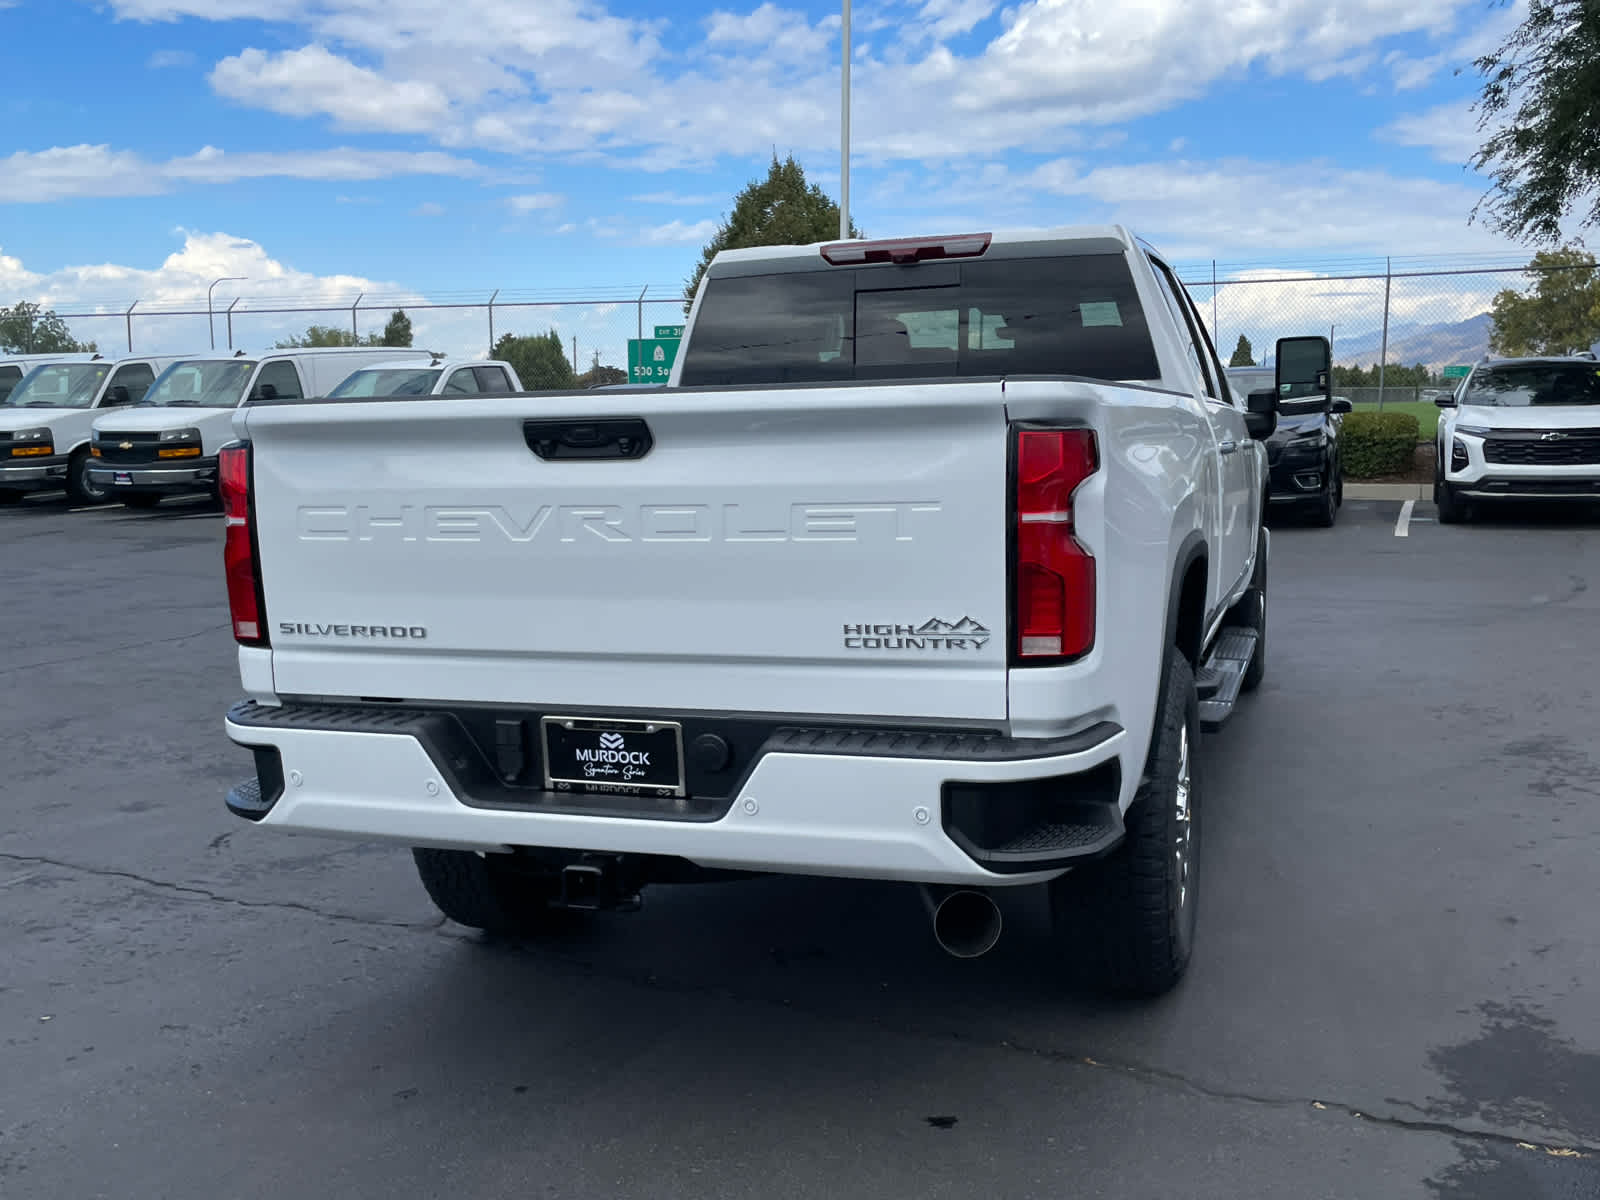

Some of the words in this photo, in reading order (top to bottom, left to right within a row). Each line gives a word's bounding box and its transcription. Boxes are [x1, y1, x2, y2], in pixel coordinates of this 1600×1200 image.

[297, 500, 941, 543] CHEVROLET
[279, 622, 427, 639] SILVERADO
[843, 624, 915, 636] HIGH
[844, 637, 990, 650] COUNTRY
[575, 748, 651, 766] MURDOCK
[583, 762, 619, 777] Signature
[622, 764, 646, 780] Series
